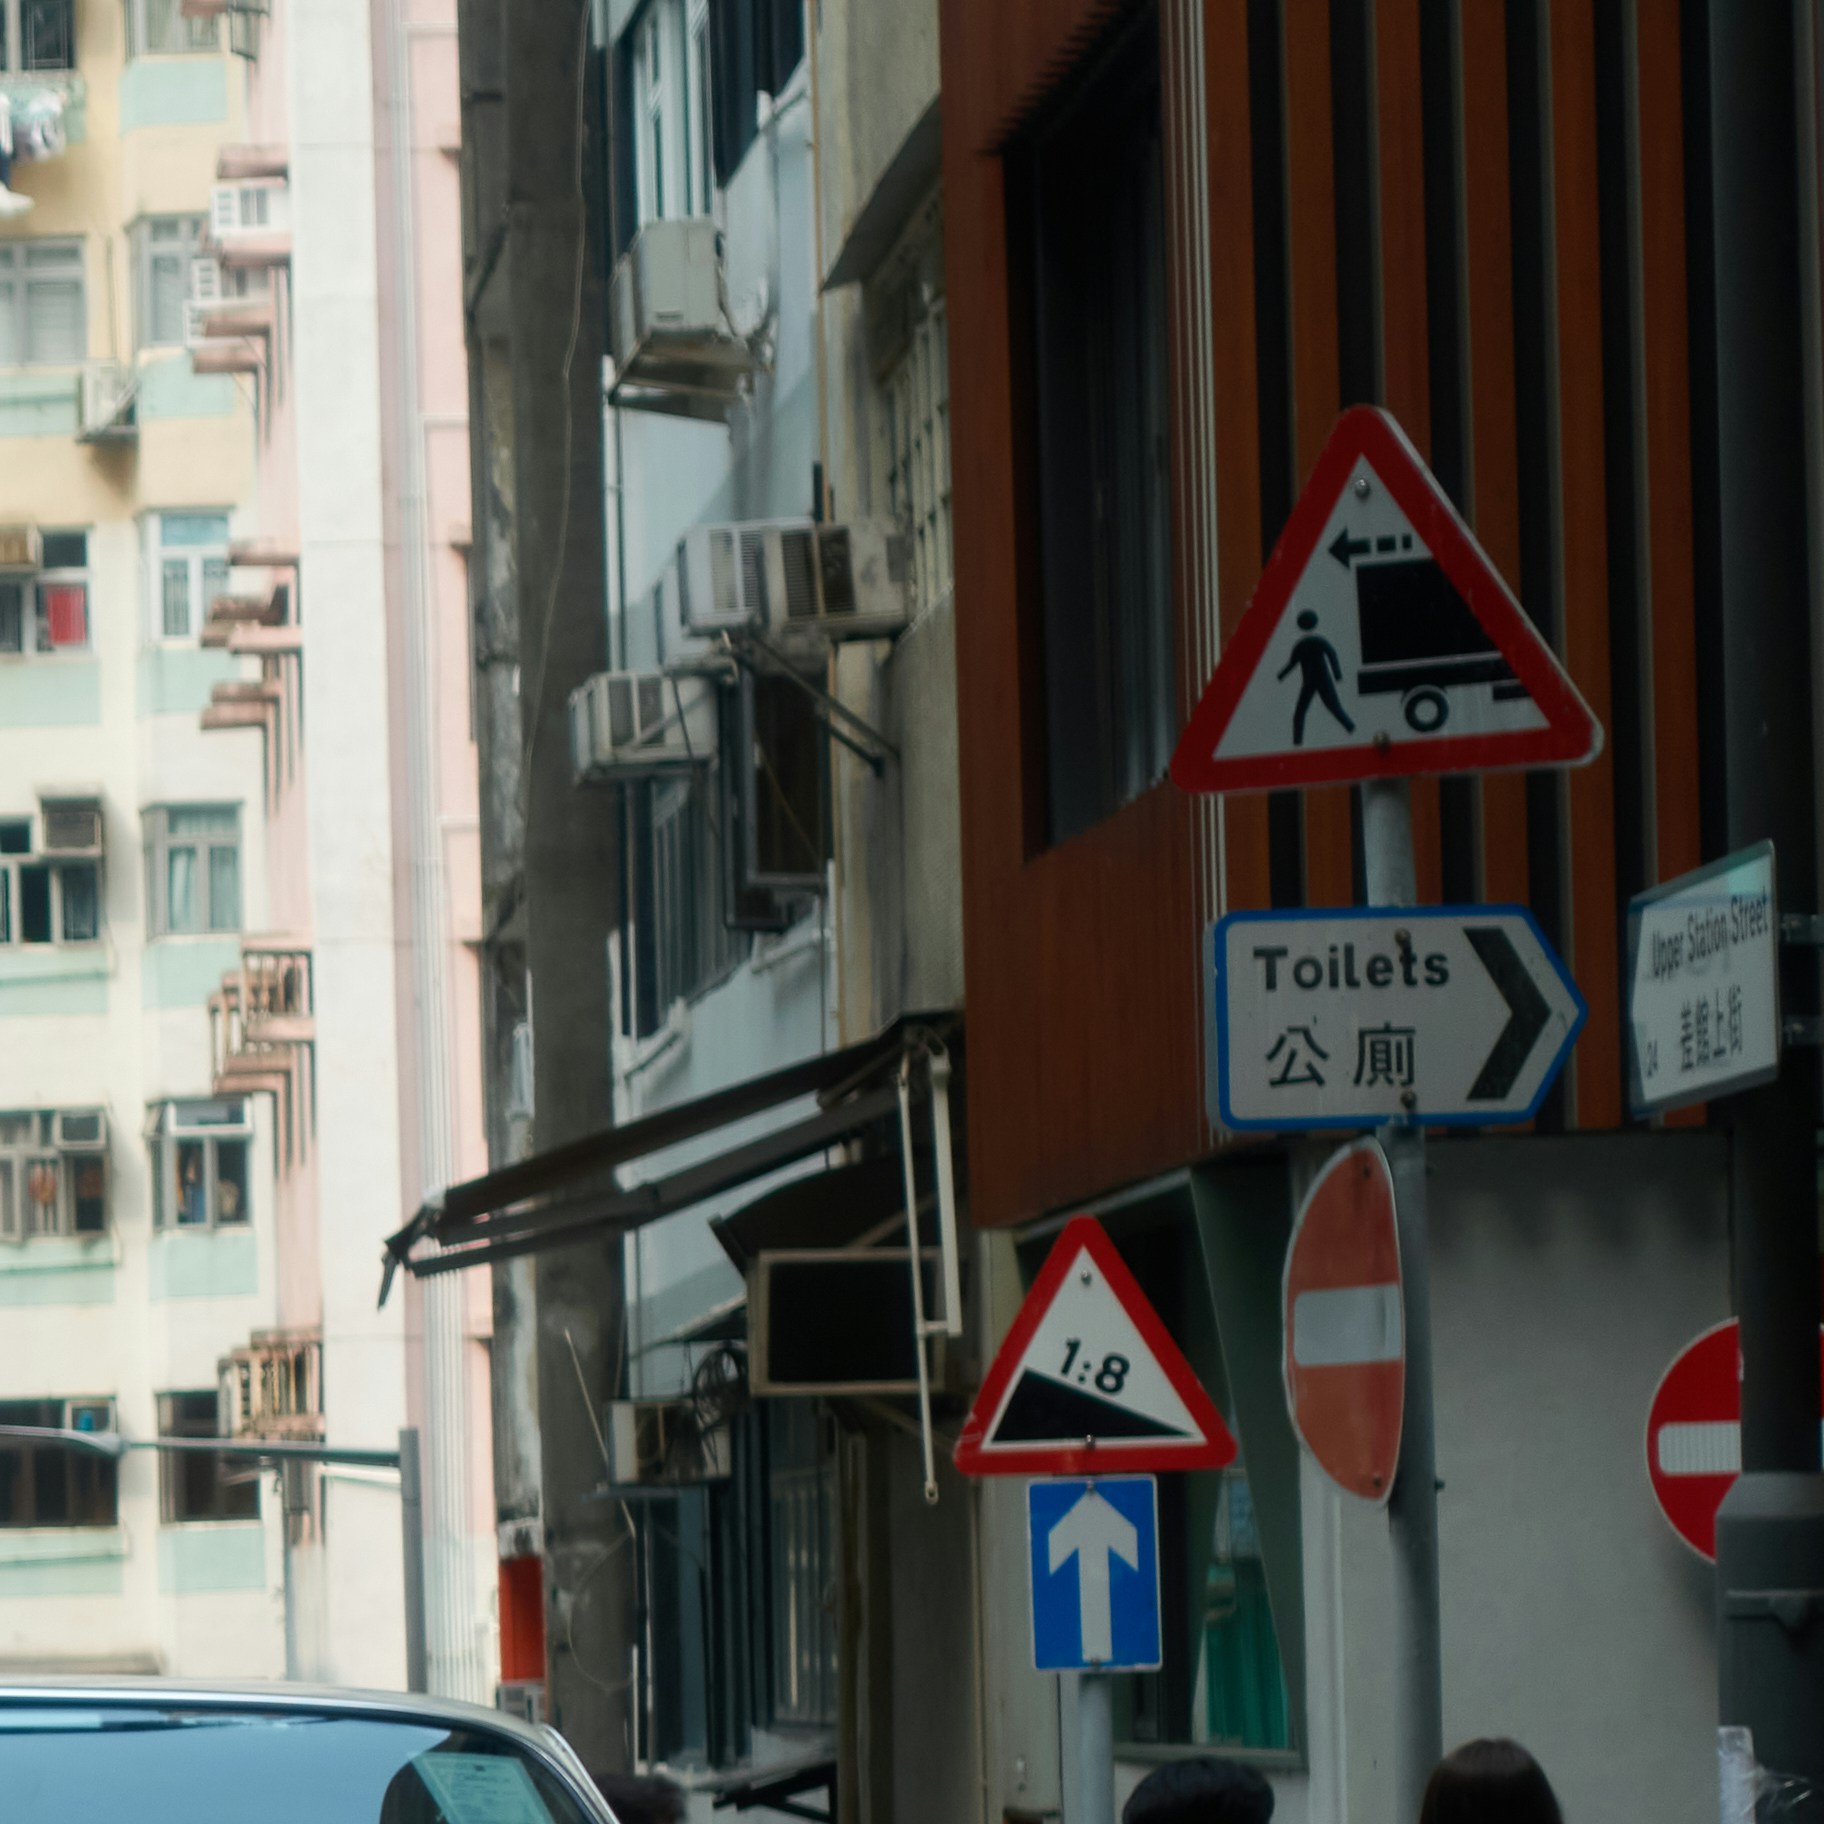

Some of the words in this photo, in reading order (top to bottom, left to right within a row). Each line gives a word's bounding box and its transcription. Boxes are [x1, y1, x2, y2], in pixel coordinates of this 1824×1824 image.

[1652, 930, 1684, 980] Upper
[1687, 907, 1728, 963] Station
[1730, 886, 1769, 946] Street
[1253, 944, 1450, 991] Toilets
[1061, 1339, 1130, 1393] 1:8
